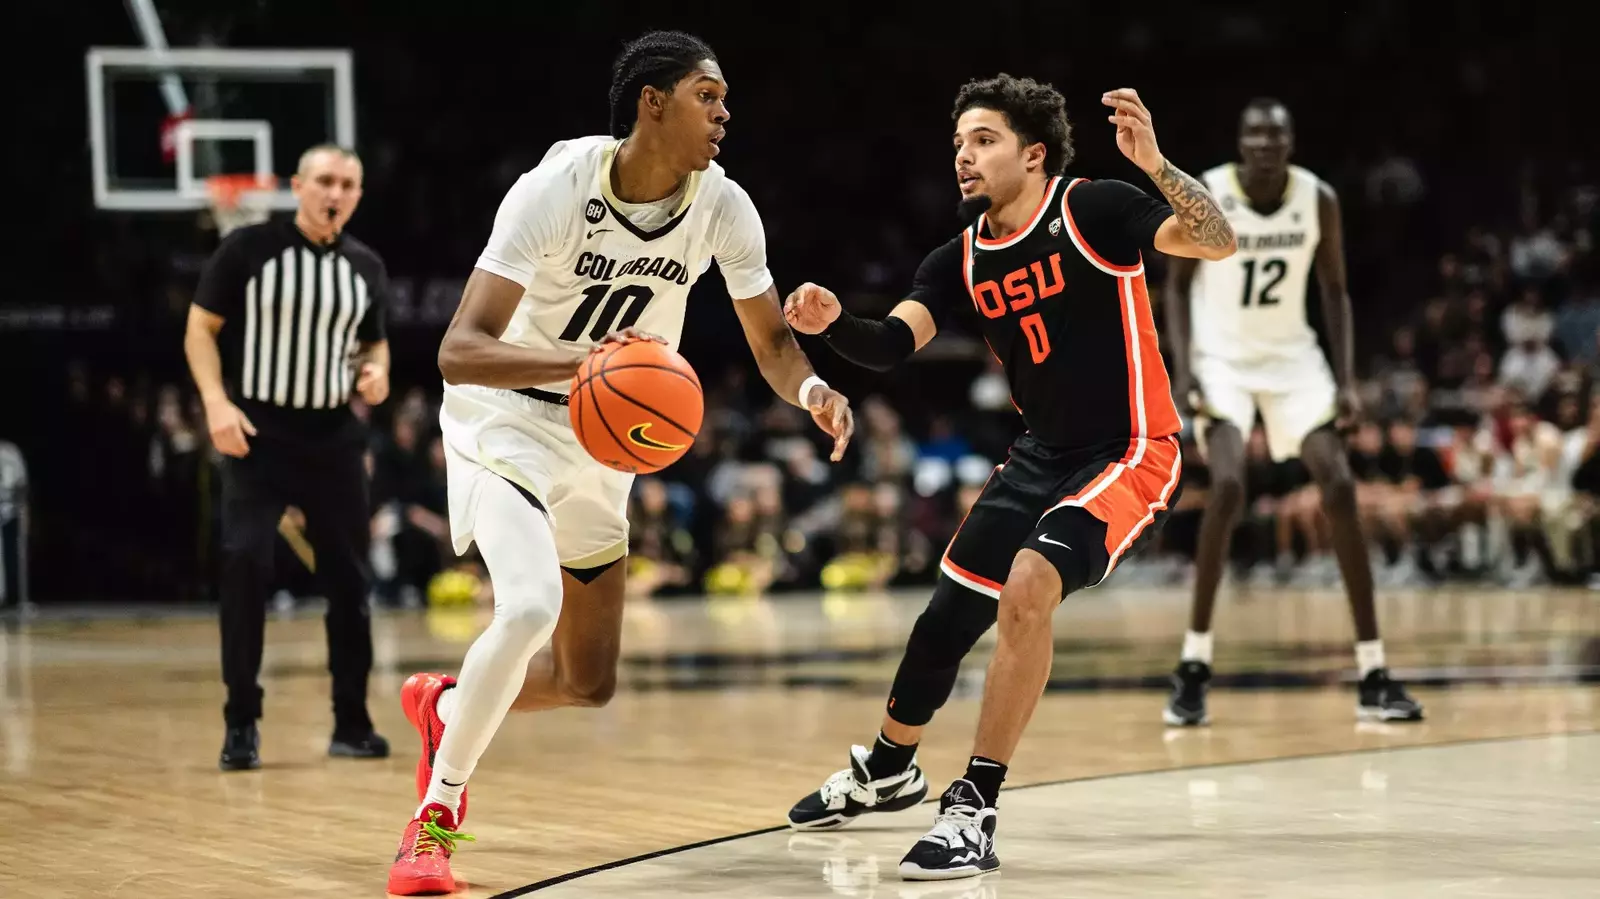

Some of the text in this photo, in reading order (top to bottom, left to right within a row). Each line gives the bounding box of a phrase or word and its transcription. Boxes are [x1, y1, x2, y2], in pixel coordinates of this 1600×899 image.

[586, 203, 604, 219] BH
[574, 252, 688, 285] COLORADO
[974, 252, 1066, 319] OSU
[1240, 258, 1288, 307] 12
[559, 284, 655, 342] 10
[1019, 312, 1052, 365] 0
